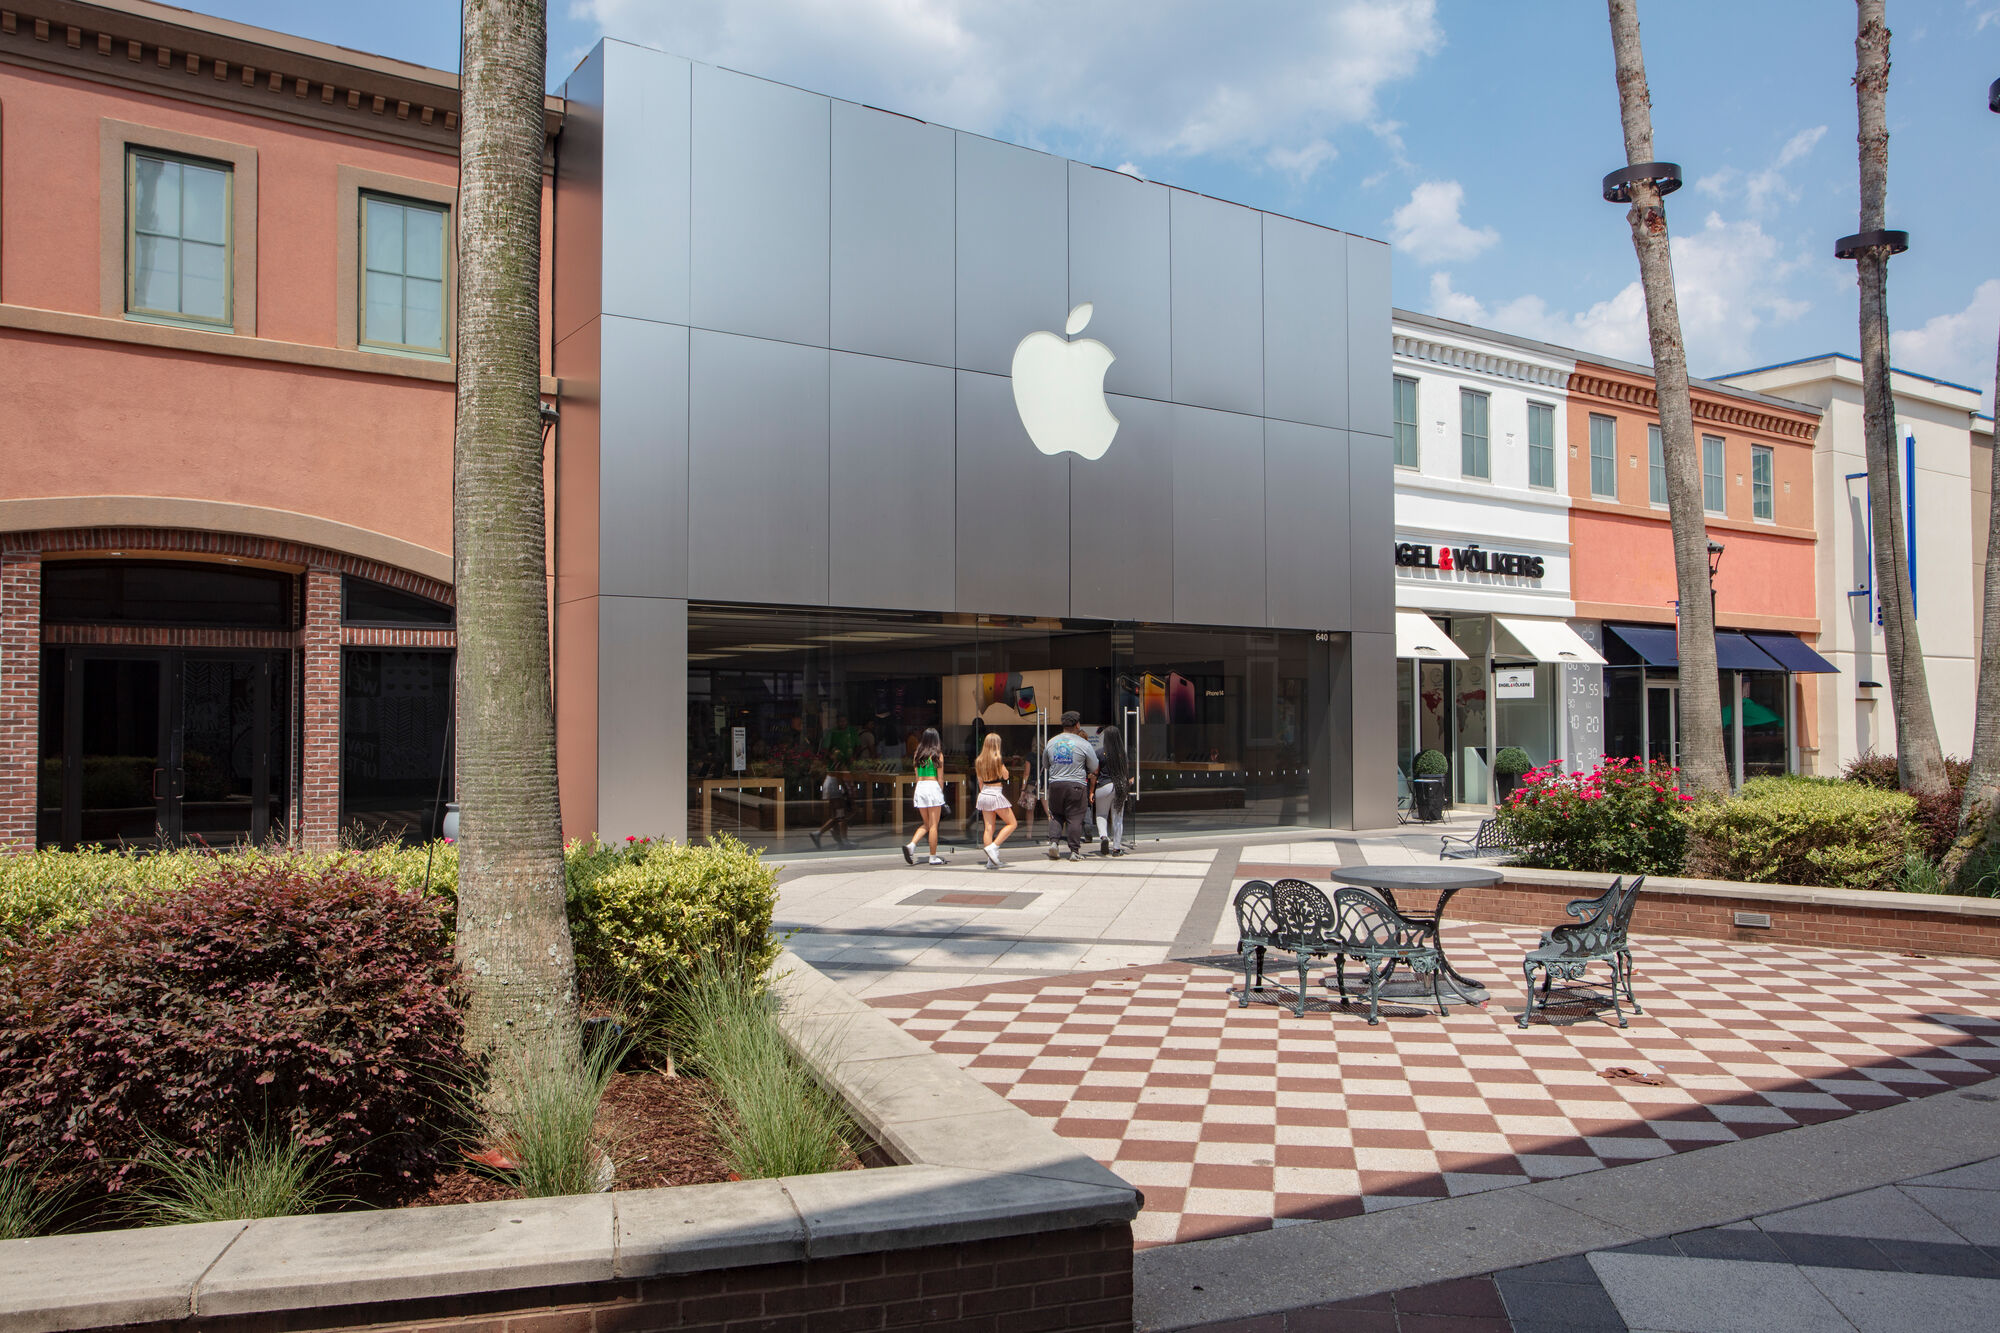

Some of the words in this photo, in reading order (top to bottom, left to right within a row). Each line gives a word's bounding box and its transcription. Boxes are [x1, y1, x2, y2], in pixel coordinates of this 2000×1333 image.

[1395, 542, 1439, 569] GEL
[1453, 544, 1545, 578] VÖLKERS
[1315, 633, 1328, 642] 640
[1572, 677, 1586, 694] 35
[1588, 683, 1599, 696] 55
[1586, 715, 1599, 733] 20
[1588, 747, 1597, 760] 30
